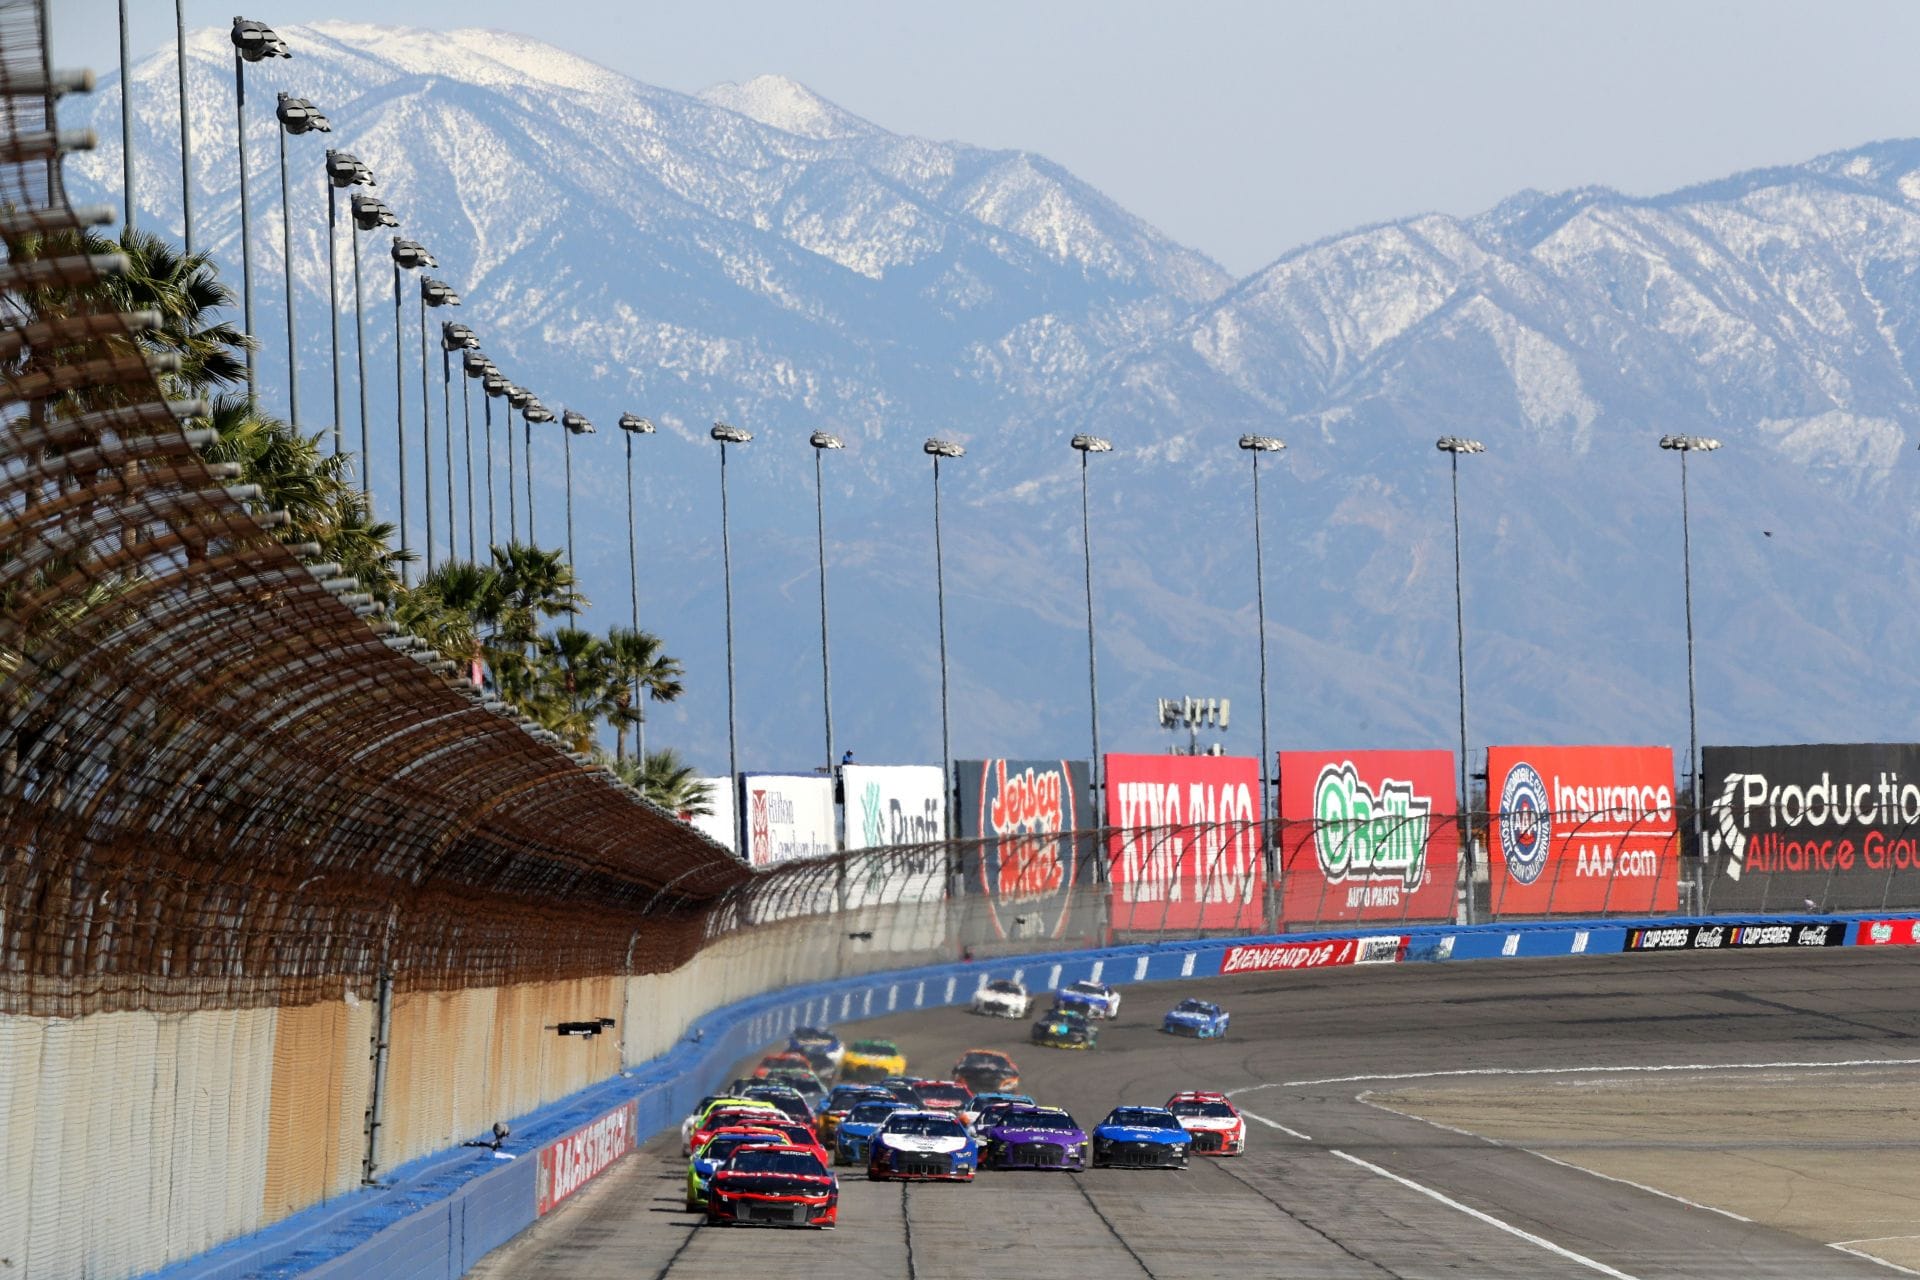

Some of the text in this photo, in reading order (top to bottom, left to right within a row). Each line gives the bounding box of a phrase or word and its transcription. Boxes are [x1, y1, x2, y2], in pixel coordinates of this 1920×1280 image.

[768, 790, 796, 825] Hilton
[991, 759, 1063, 841] Jersey
[1553, 774, 1672, 824] Insurance
[1118, 782, 1256, 904] KING TACO
[1317, 767, 1428, 886] O'Reilly
[1575, 843, 1657, 877] AAA.com
[1745, 831, 1856, 873] Alliance
[1346, 885, 1399, 907] AUTO PARTS
[1642, 928, 1689, 948] CUP SERIES
[1742, 926, 1792, 945] CUP SERIES
[1224, 946, 1334, 972] BIENVENIDOS
[1336, 941, 1353, 963] A
[554, 1106, 628, 1202] BACKSTRETCH
